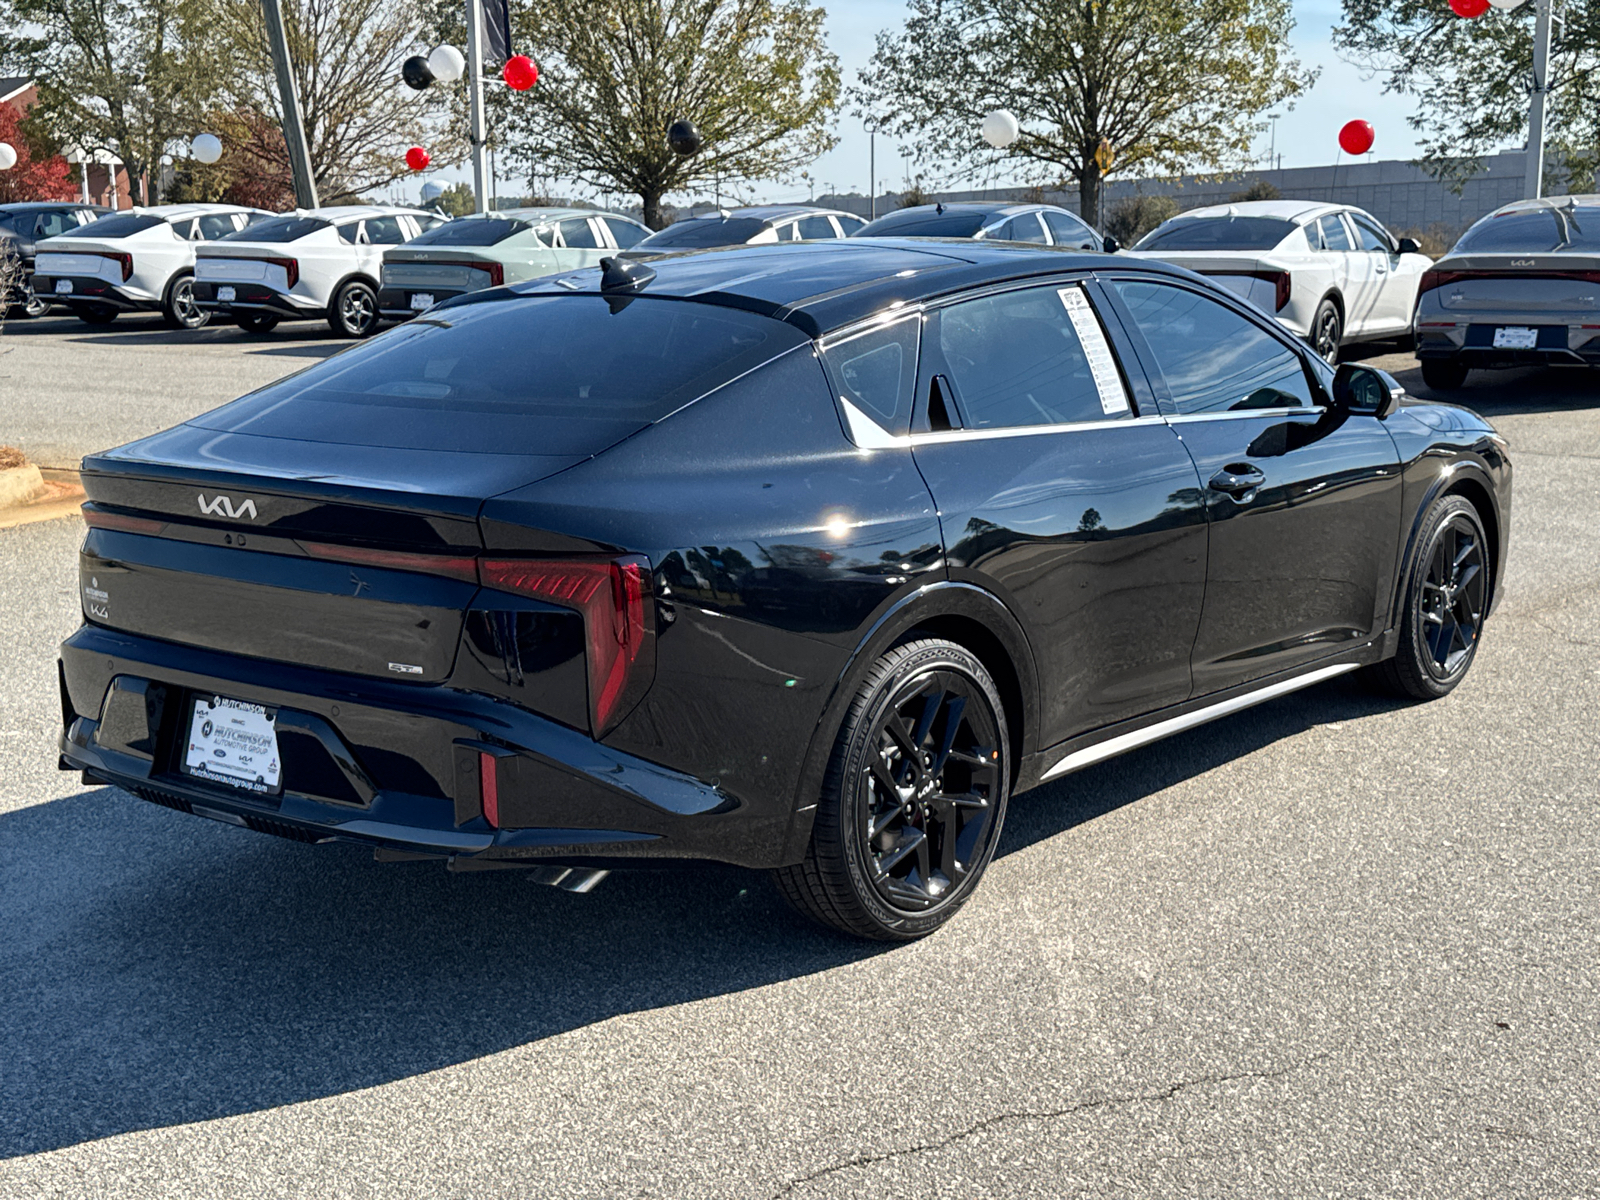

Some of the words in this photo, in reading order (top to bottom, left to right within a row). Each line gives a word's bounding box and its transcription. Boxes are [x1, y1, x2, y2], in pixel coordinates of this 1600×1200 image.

[197, 493, 258, 520] KIA
[90, 604, 109, 619] K4
[221, 698, 267, 714] HUTCHINSON
[214, 725, 272, 748] HUTCHINSON
[213, 738, 247, 751] AUTOMOTIVE
[248, 743, 268, 755] GROUP
